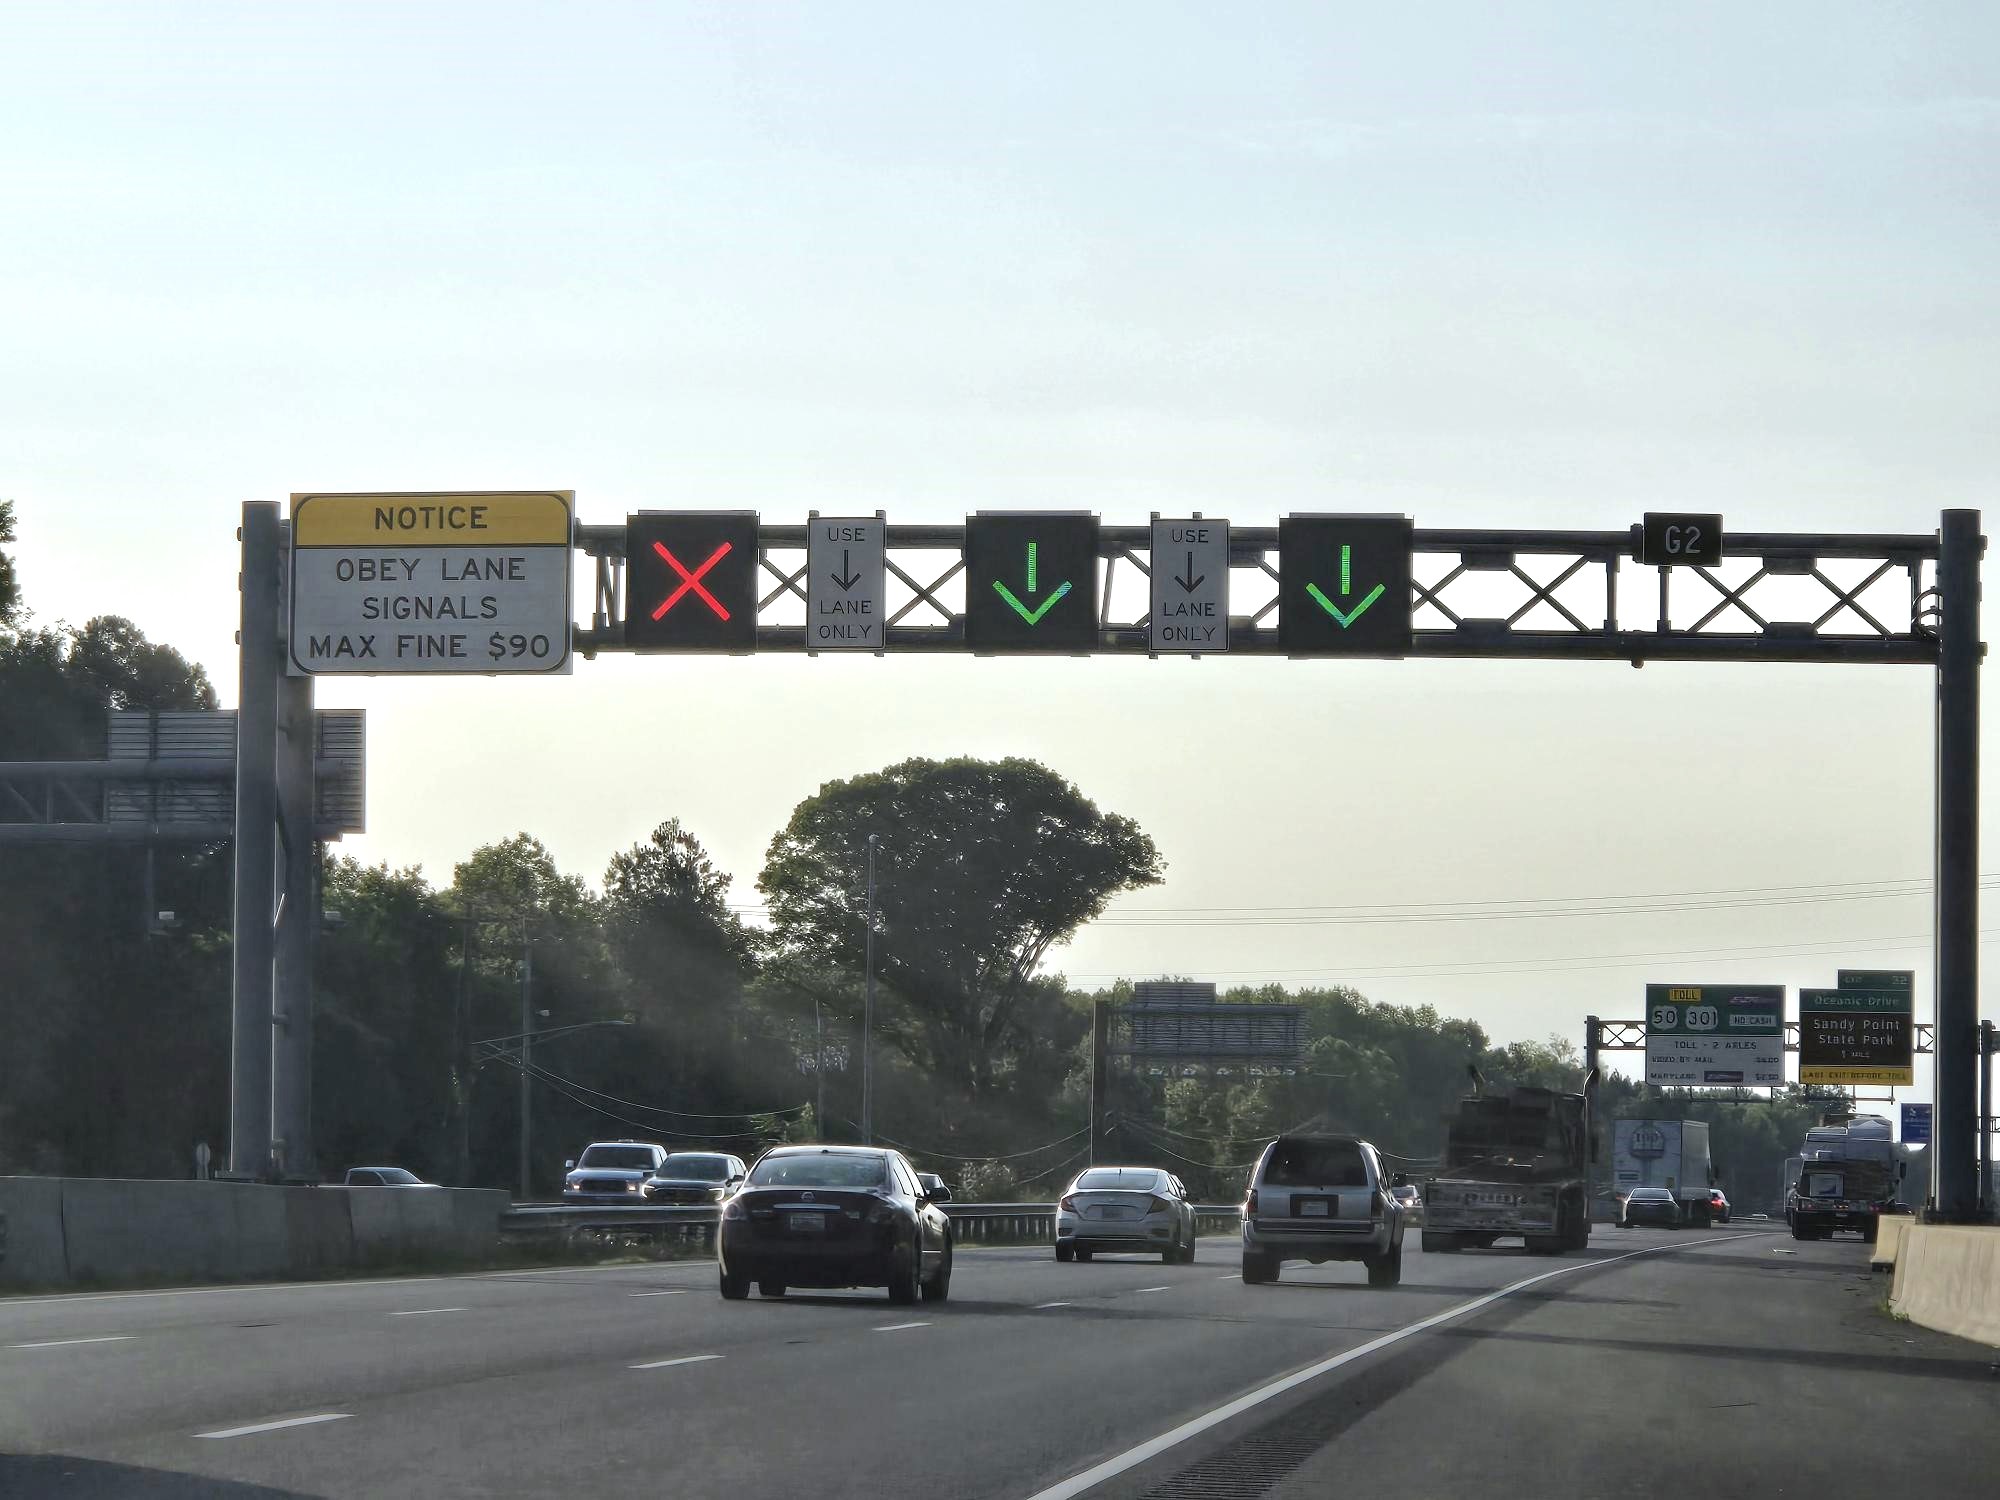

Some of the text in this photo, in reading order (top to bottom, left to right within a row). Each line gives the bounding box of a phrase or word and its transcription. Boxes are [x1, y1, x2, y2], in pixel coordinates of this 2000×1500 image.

[374, 506, 488, 530] NOTICE
[828, 528, 865, 542] USE
[1172, 529, 1209, 543] USE
[1665, 525, 1701, 554] G2
[336, 557, 526, 582] OBEY LANE
[362, 596, 499, 620] SIGNALS
[820, 600, 872, 615] LANE
[1163, 602, 1216, 617] LANE
[820, 625, 872, 639] ONLY
[1162, 627, 1216, 641] ONLY
[309, 631, 550, 661] MAX FINE $90
[1673, 990, 1697, 1000] TOLL
[1868, 996, 1900, 1006] Drive
[1654, 1010, 1676, 1023] 50
[1688, 1011, 1717, 1025] 301
[1734, 1016, 1772, 1025] NO CASH
[1813, 1019, 1900, 1032] Sandy Point
[1674, 1041, 1698, 1049] TOLL
[1725, 1041, 1757, 1050] AXLES
[1819, 1034, 1893, 1046] State Park
